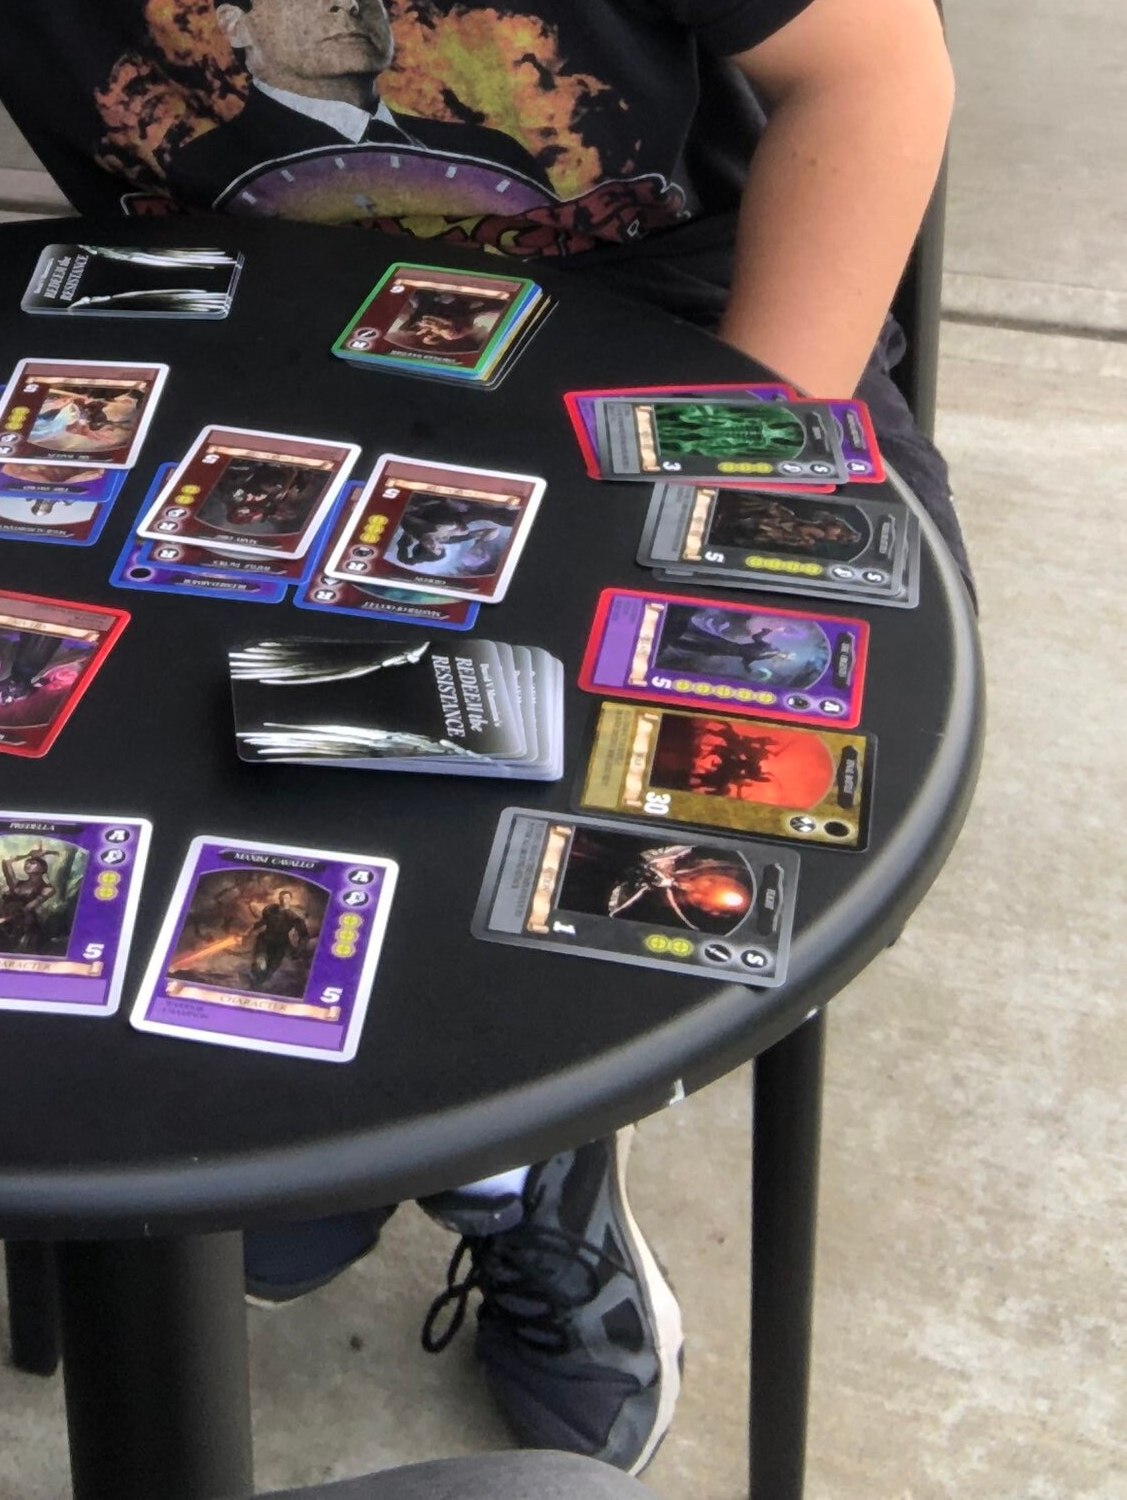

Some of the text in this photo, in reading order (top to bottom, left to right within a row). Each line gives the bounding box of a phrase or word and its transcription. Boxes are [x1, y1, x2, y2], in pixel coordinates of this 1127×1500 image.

[202, 454, 220, 465] 5
[662, 461, 682, 471] 3
[381, 488, 400, 499] 5
[704, 551, 725, 563] 5
[651, 675, 672, 690] 5
[431, 655, 466, 738] RESISTANCE
[455, 656, 489, 733] REDEEM the
[643, 791, 672, 816] 30
[553, 920, 576, 935] 1
[83, 943, 105, 959] 5
[320, 987, 344, 1003] 5
[219, 995, 287, 1012] CHARACTER
